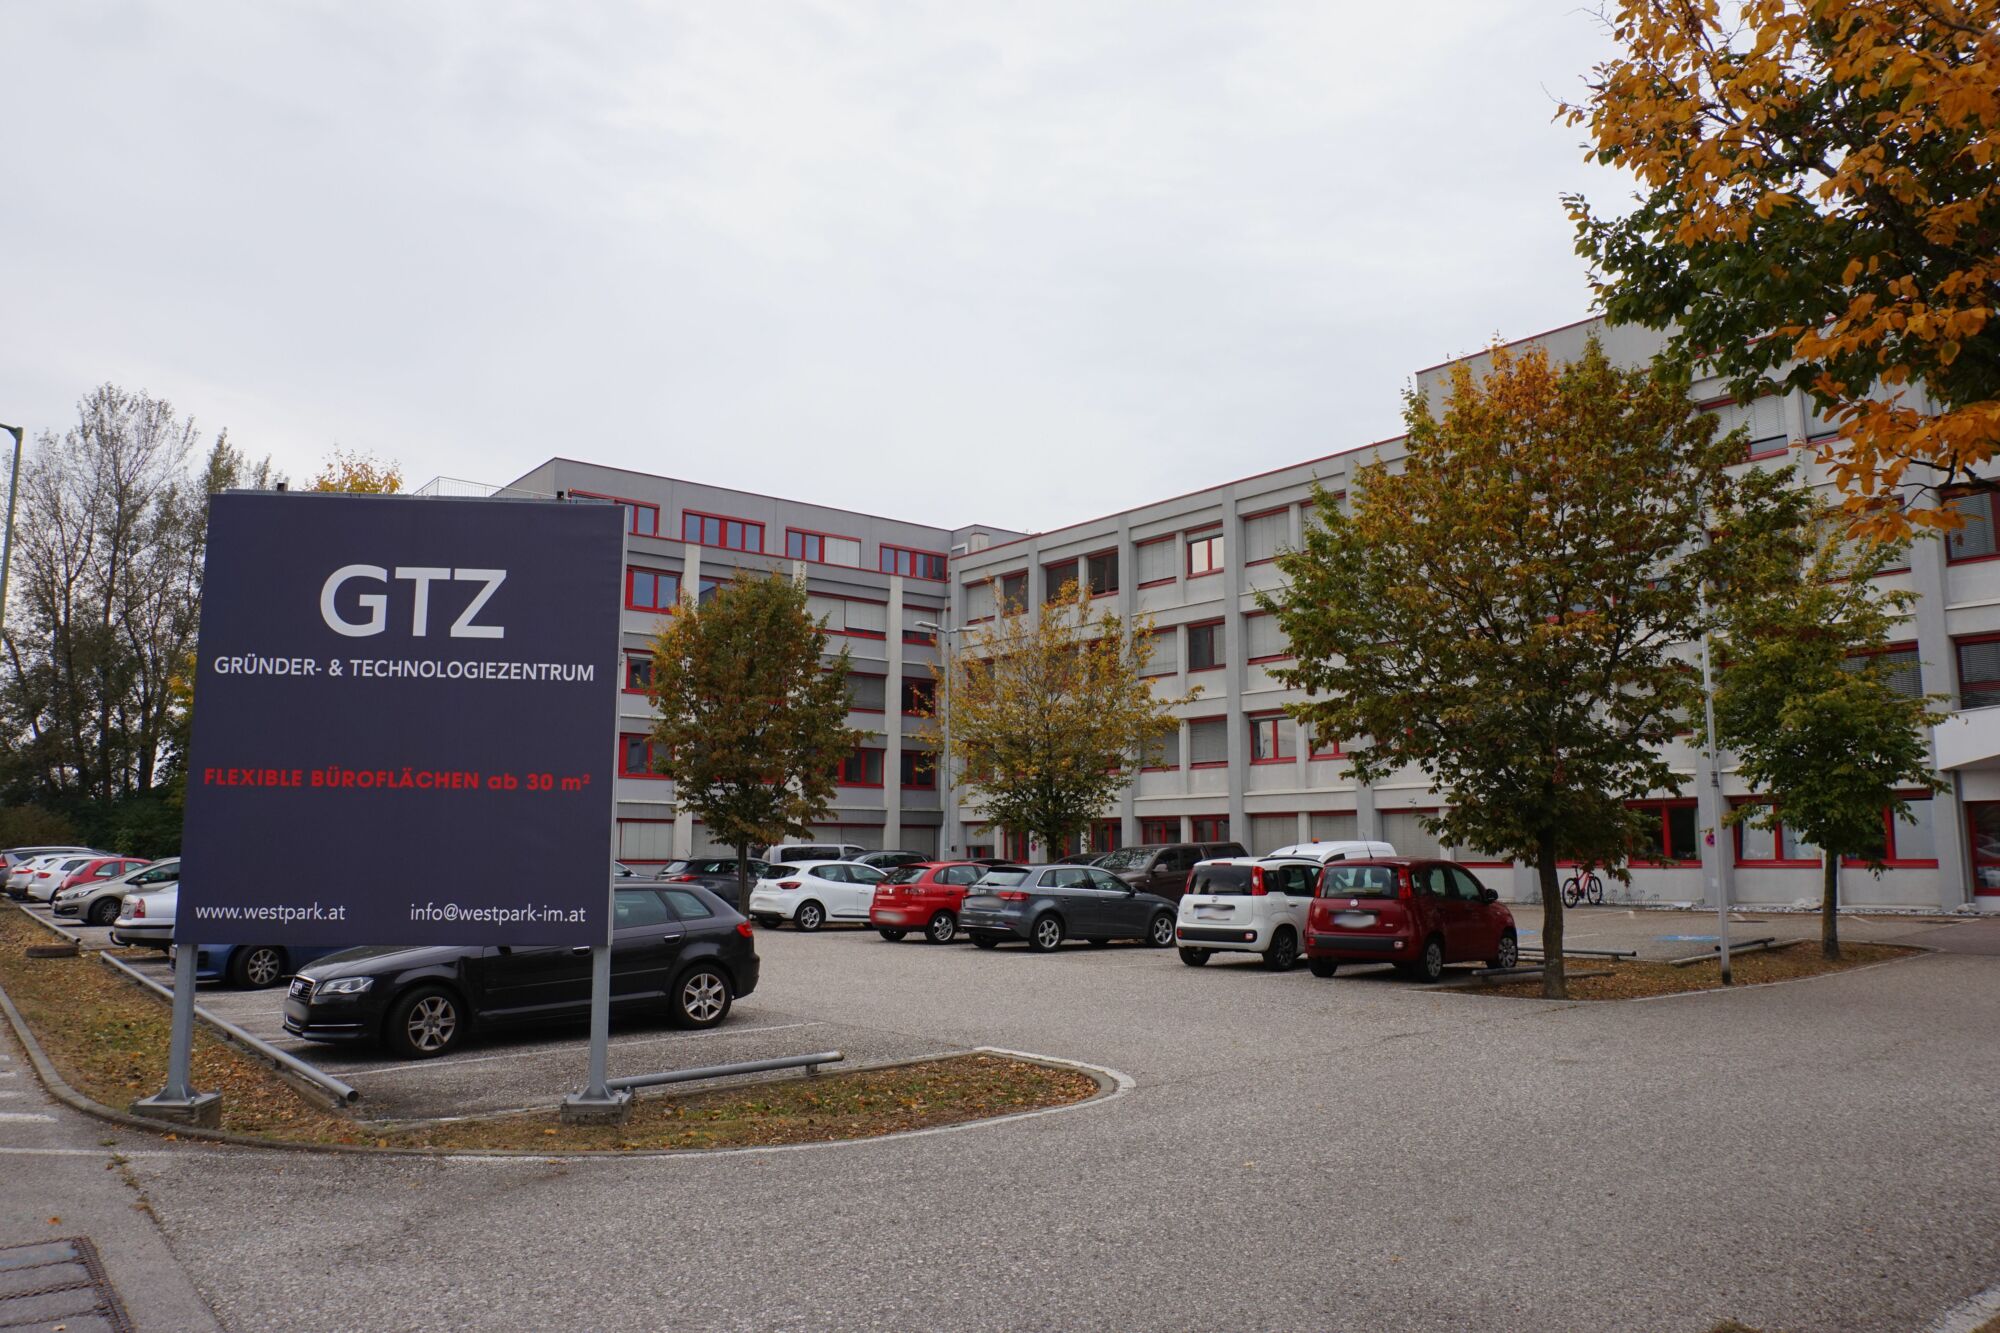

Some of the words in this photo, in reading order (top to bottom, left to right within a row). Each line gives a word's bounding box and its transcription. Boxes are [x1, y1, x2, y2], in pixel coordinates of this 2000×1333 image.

[320, 564, 507, 639] GTZ
[214, 654, 322, 676] GRÜNDER-
[329, 659, 344, 677] &
[350, 660, 595, 682] TECHNOLOGIEZENTRUM
[204, 768, 304, 787] FLEXIBLE
[310, 765, 481, 790] BÜROFLÄCHEN
[487, 773, 519, 791] ab
[527, 773, 555, 792] 30
[195, 902, 346, 925] www.westpark.at
[410, 903, 586, 926] info@westpark-im.at
